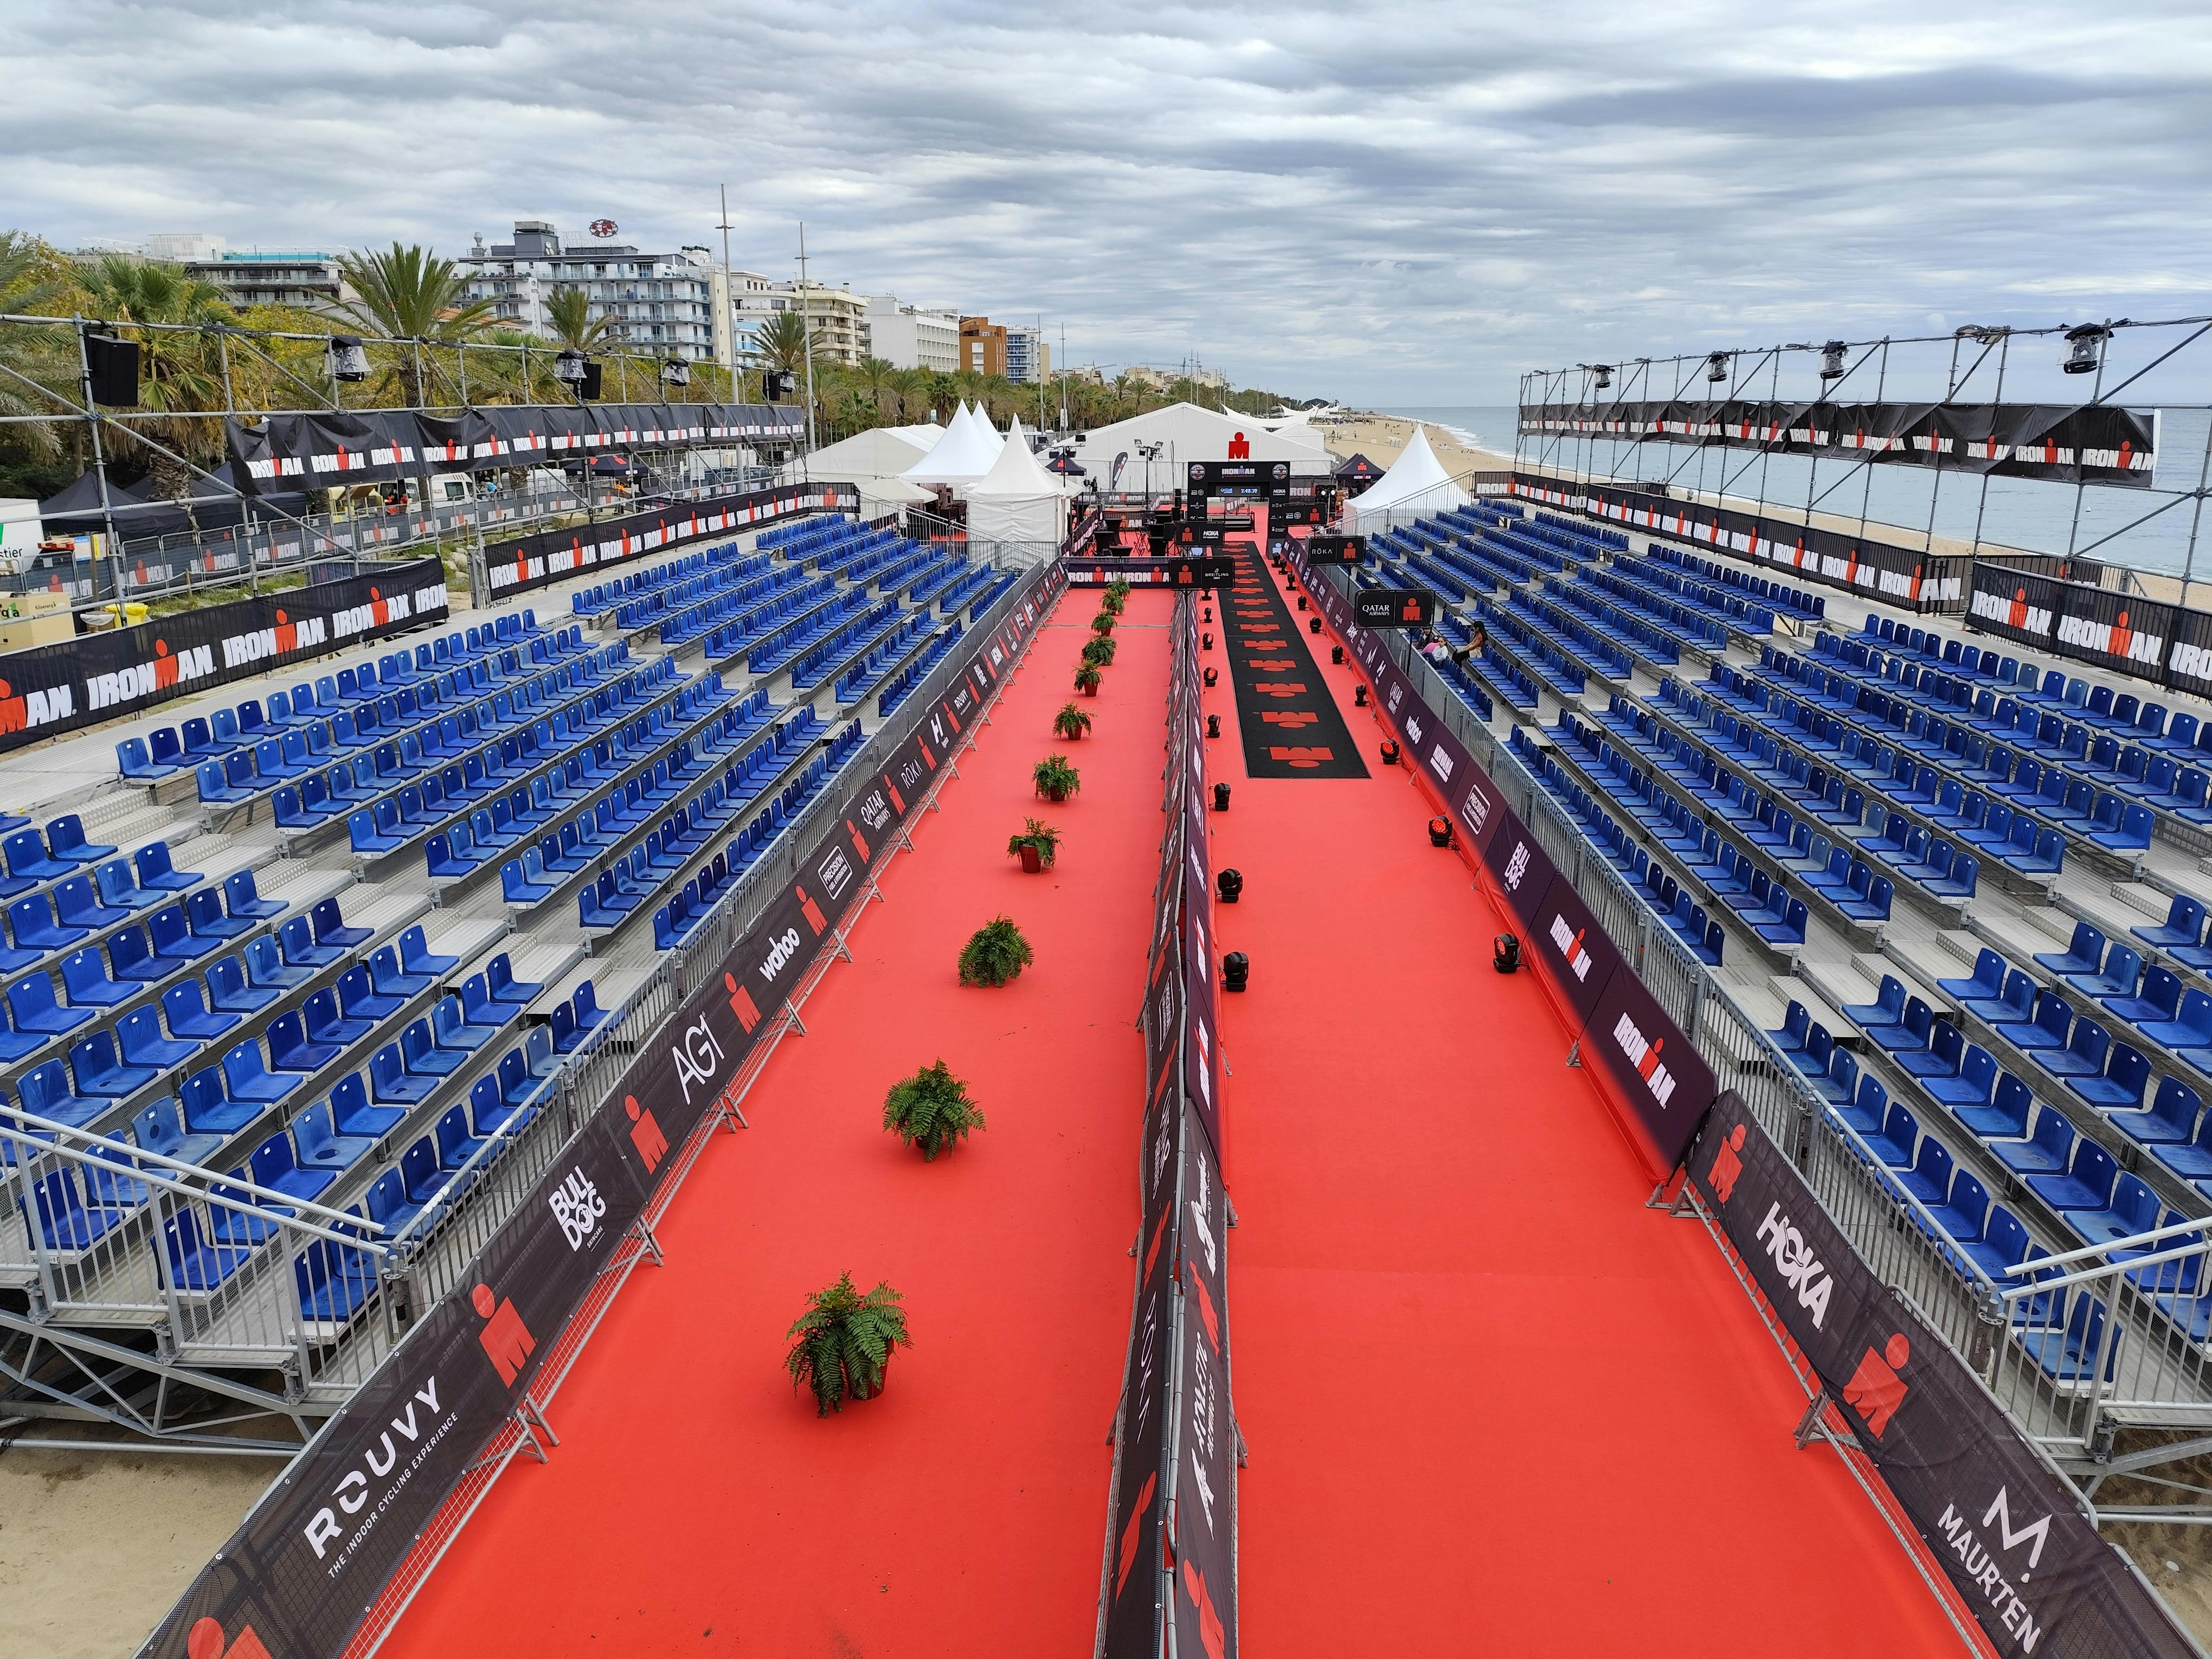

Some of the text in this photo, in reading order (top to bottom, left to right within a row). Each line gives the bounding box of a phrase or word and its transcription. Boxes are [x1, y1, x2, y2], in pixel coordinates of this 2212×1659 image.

[371, 438, 415, 466] IRONMAN
[422, 438, 468, 462] IRONMAN
[474, 434, 510, 458] IRONMAN
[513, 429, 546, 452] IRONMAN
[1912, 428, 1953, 453] IRONMAN
[2016, 437, 2074, 465] IRONMAN
[1222, 465, 1255, 475] IRONMAN
[644, 518, 677, 550] IRONMAN
[678, 510, 707, 540] IRONMAN
[708, 505, 736, 533] IRONMAN
[1662, 510, 1693, 537] IRONMAN
[1694, 518, 1729, 547] IRONMAN
[548, 537, 597, 573] IRONMAN
[599, 528, 642, 561] IRONMAN
[1731, 526, 1770, 558] IRONMAN
[1773, 537, 1819, 572] IRONMAN
[489, 548, 545, 589] IRONMAN
[1821, 550, 1875, 588] IRONMAN
[332, 586, 410, 639] IRONMAN
[1362, 605, 1390, 613] QATAR
[1971, 588, 2052, 637] IRONMAN
[221, 609, 325, 668] IRONMAN
[2057, 611, 2162, 666] IRONMAN
[86, 639, 214, 711] IRONMAN
[954, 688, 969, 710] ROUVY
[1389, 681, 1403, 705] QATAR
[1405, 715, 1422, 744] wahoo
[1432, 743, 1454, 776] NIRVANA
[861, 789, 885, 826] QATAR
[872, 807, 891, 832] AIRWAYS
[1469, 792, 1487, 820] PRECISION
[822, 853, 845, 885] PRECISION
[1504, 858, 1523, 890] DOG
[1513, 841, 1531, 874] BULL
[758, 927, 801, 982] wahoo
[1549, 912, 1592, 982] IRONMAN
[672, 1015, 725, 1105] AG1
[1613, 1012, 1676, 1108] IRONMAN
[548, 1165, 594, 1226] BULL
[562, 1188, 606, 1252] DOG
[587, 1225, 604, 1249] SKINCARE
[1756, 1201, 1834, 1329] HOKA
[303, 1375, 441, 1560] ROUVY
[327, 1411, 459, 1578] THE INDOOR CYCLING EXPERIENCE
[1937, 1502, 2041, 1654] MAURTEN
